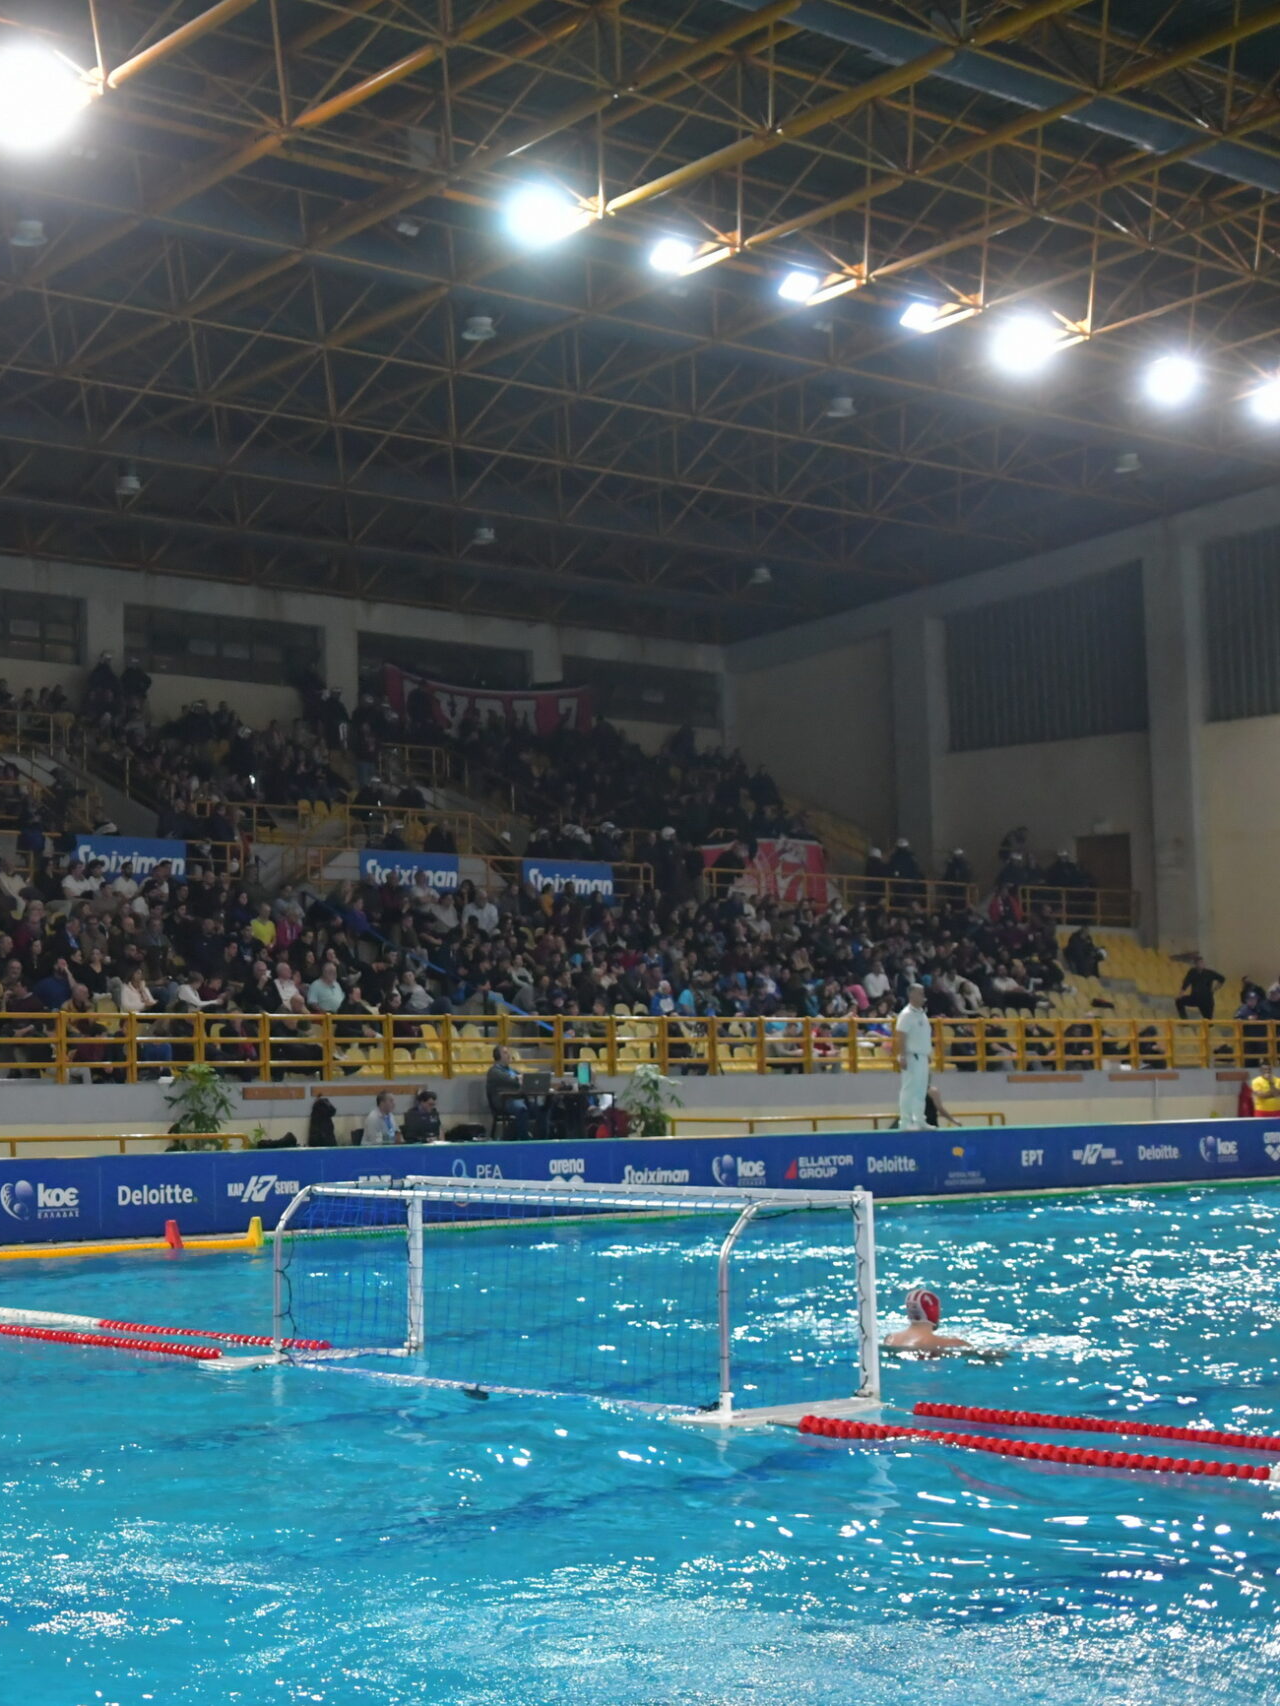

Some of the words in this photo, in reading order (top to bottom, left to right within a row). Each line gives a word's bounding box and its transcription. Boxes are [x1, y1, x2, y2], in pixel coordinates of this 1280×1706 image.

[549, 1159, 584, 1174] arena
[798, 1155, 854, 1168] ELLAKTOR
[621, 1165, 690, 1184] Stoiximan
[798, 1167, 838, 1179] GROUP
[227, 1183, 244, 1197] KAP
[274, 1180, 300, 1195] SEVEN
